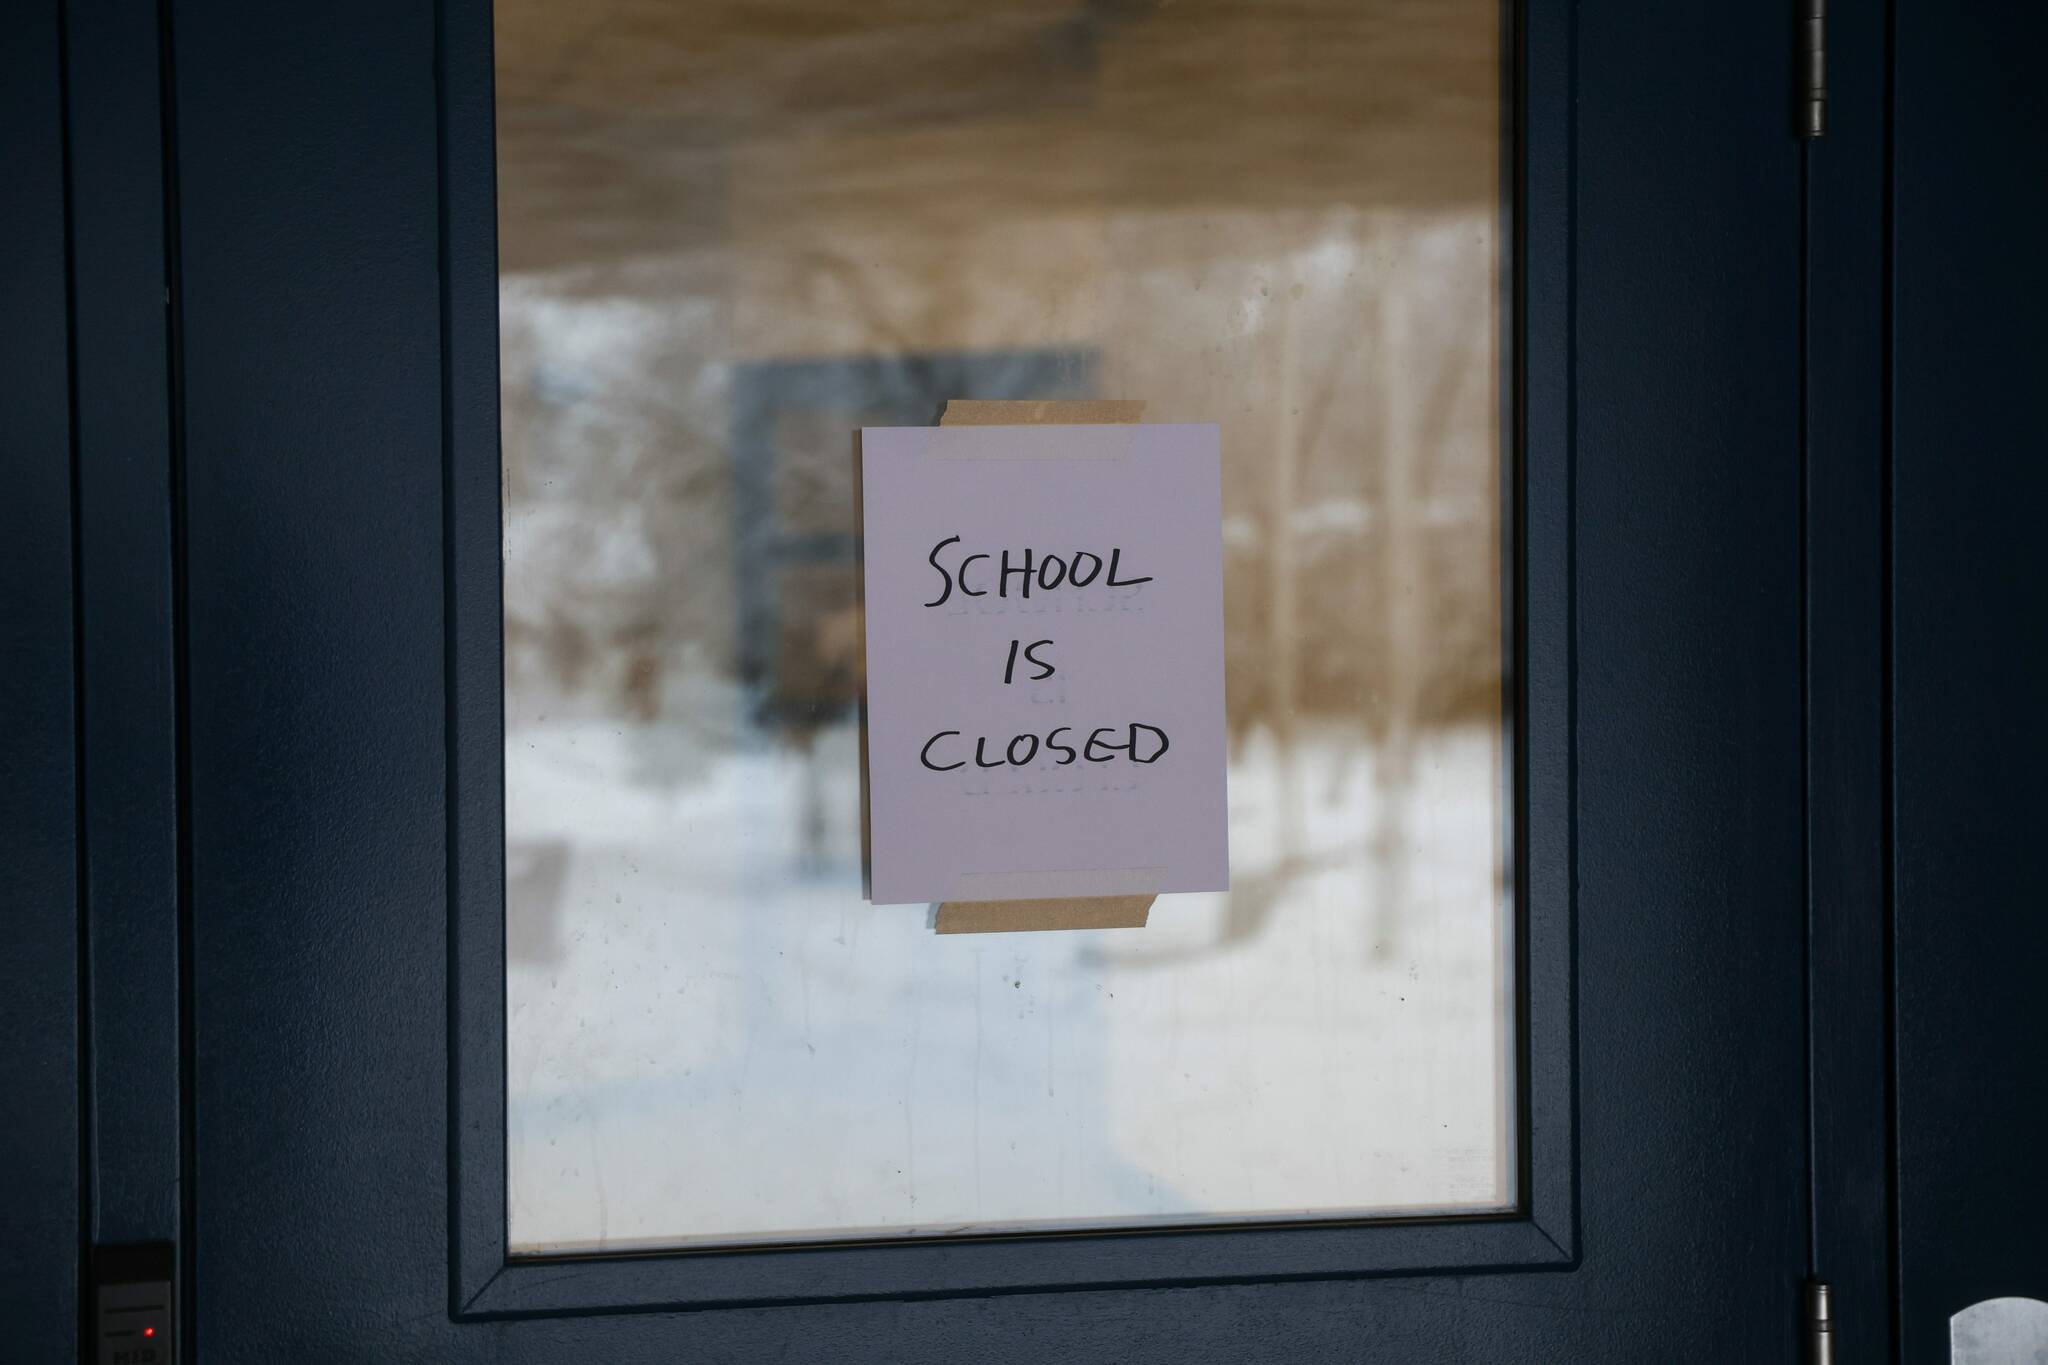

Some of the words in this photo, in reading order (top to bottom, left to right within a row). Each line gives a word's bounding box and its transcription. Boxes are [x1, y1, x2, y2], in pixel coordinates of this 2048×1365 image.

[924, 535, 1153, 608] SCHOOL
[1004, 640, 1055, 684] IS
[921, 723, 1169, 771] CLOSED
